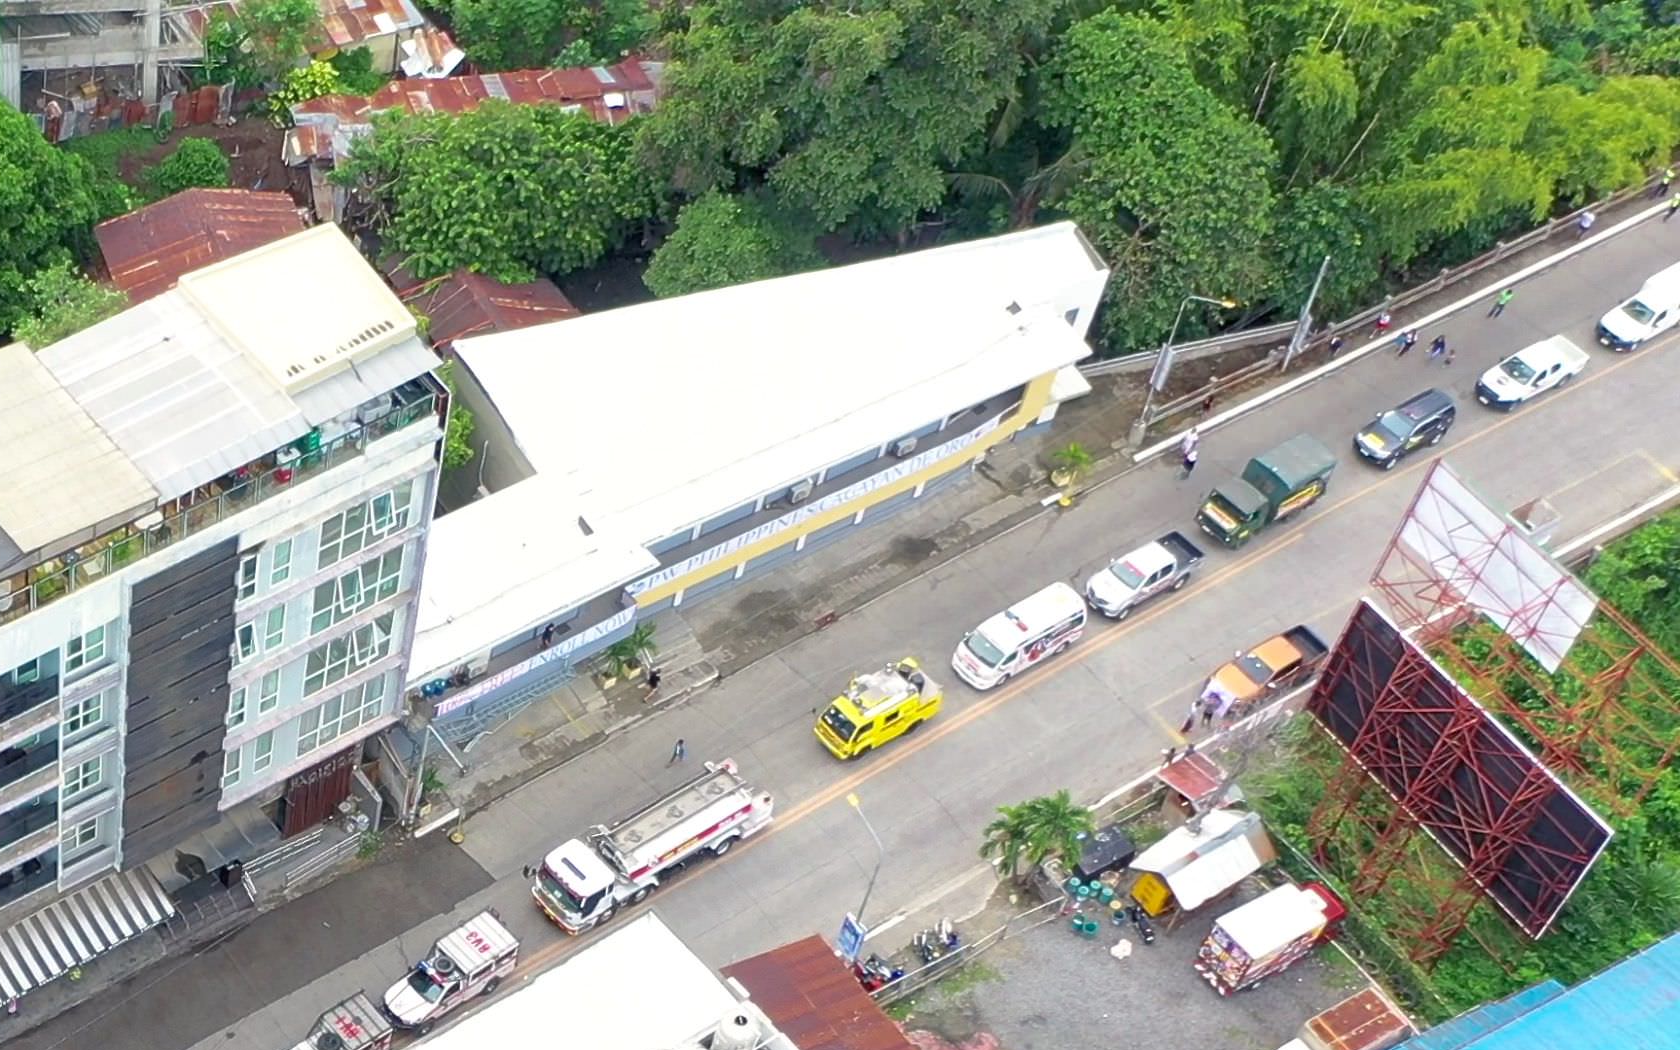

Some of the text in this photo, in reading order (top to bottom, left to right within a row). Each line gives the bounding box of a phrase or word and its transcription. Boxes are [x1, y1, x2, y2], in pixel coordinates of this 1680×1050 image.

[687, 503, 816, 571] PHILIPPINES
[818, 463, 905, 513] CAGAYAN
[934, 435, 973, 459] ORO
[528, 605, 636, 669] ENROLL NOW
